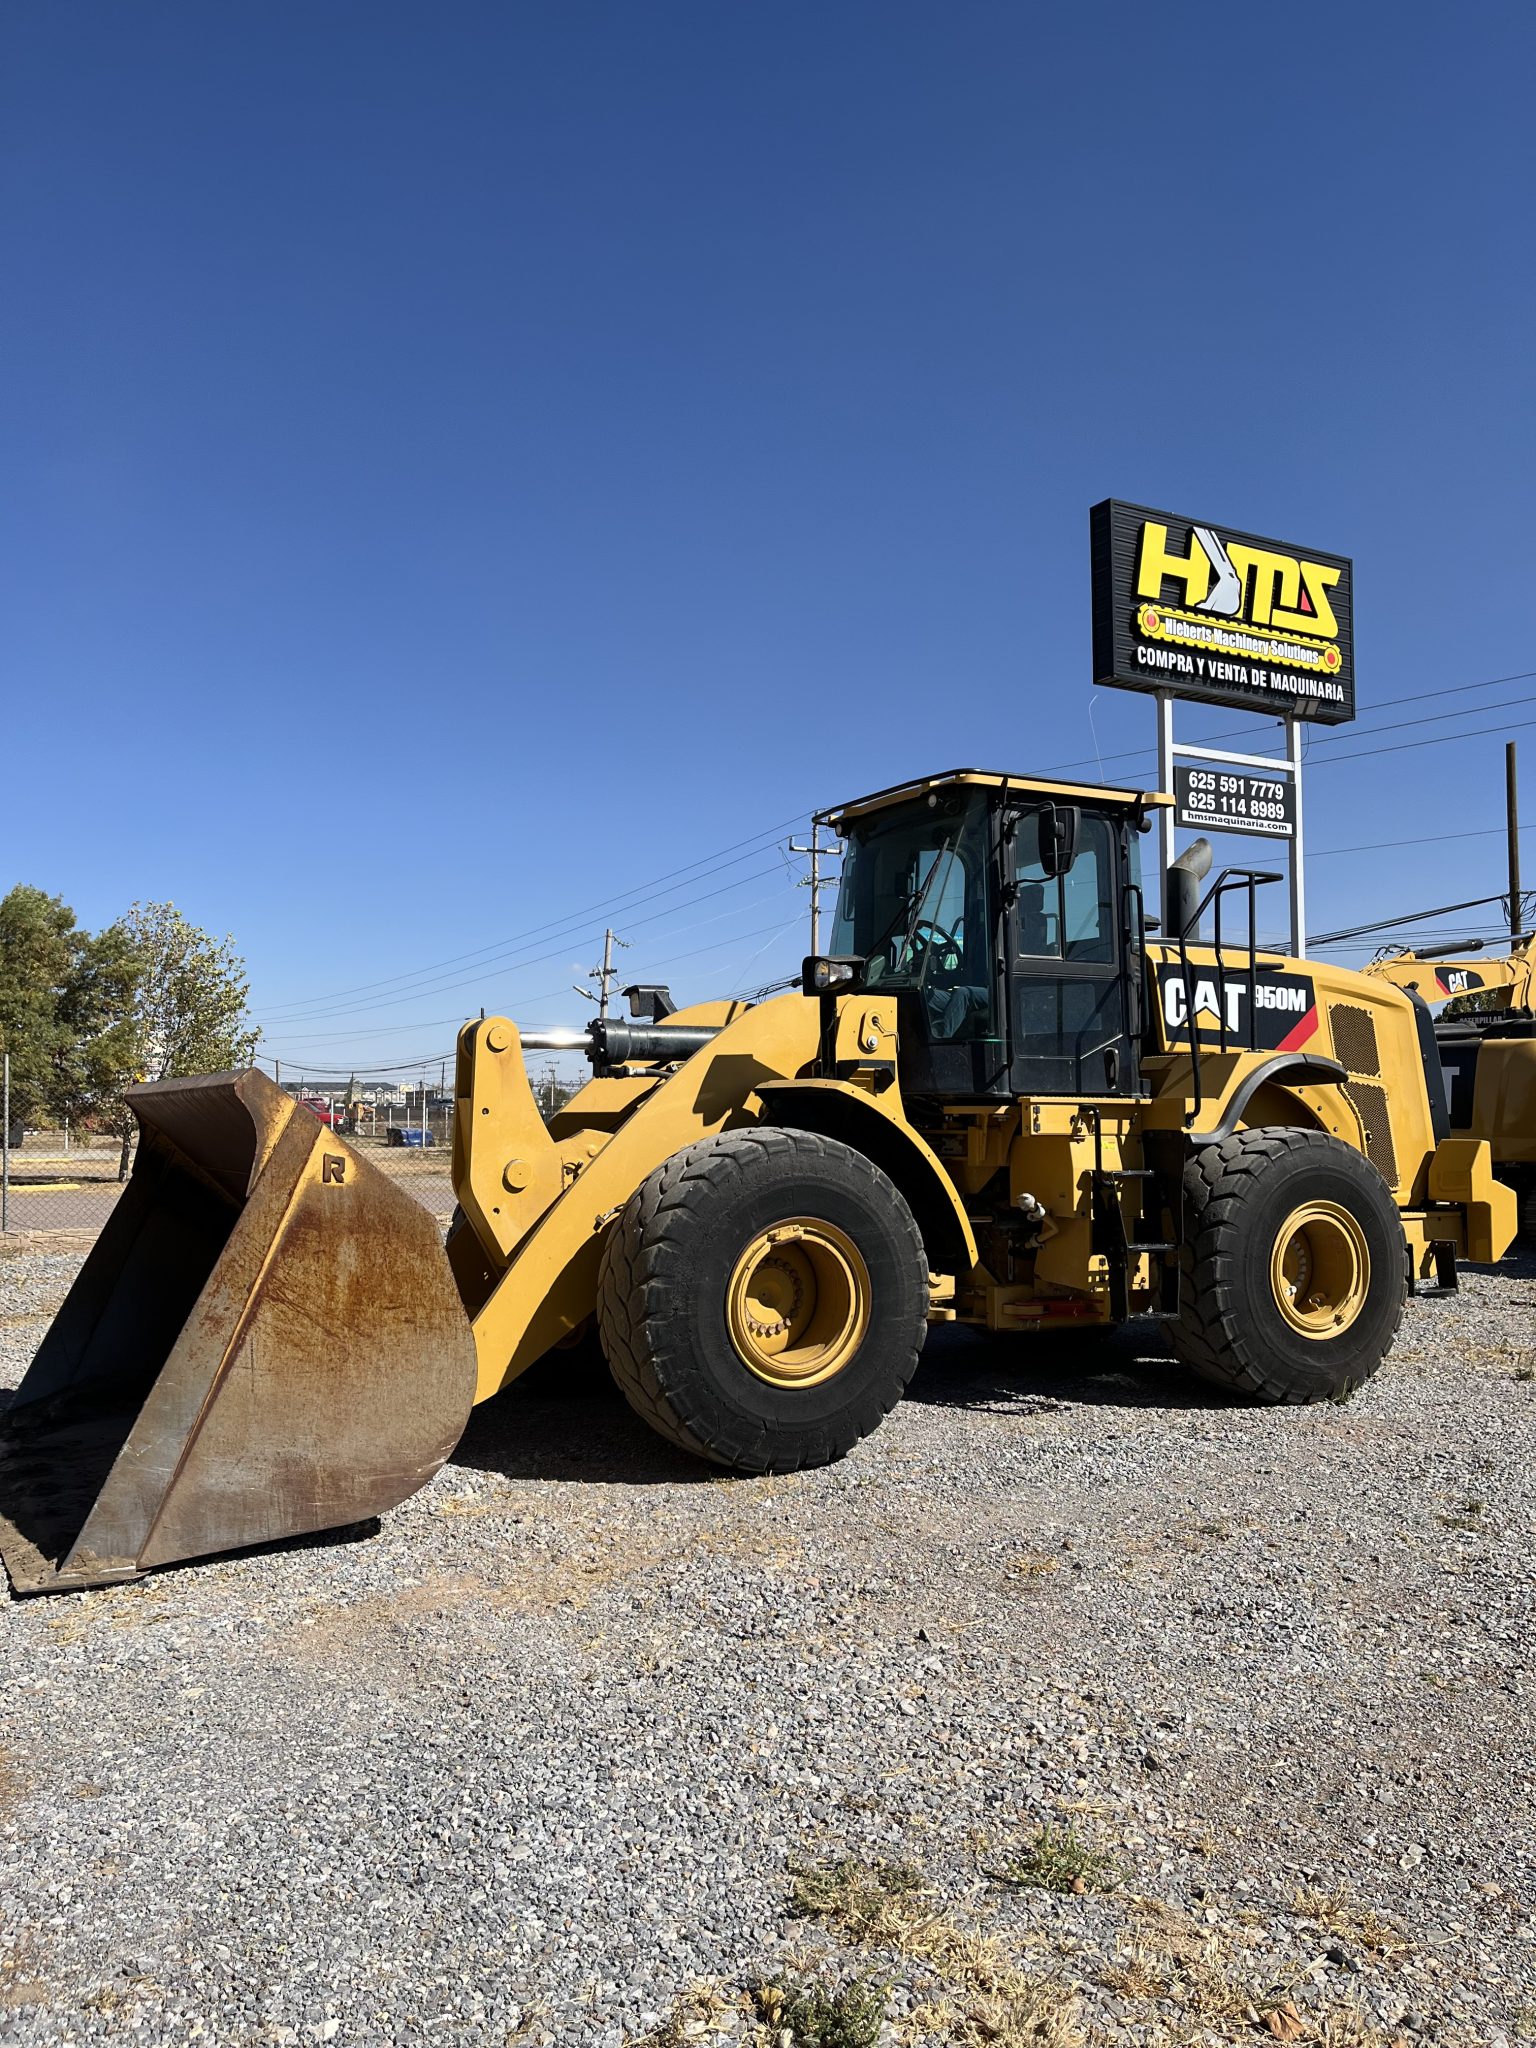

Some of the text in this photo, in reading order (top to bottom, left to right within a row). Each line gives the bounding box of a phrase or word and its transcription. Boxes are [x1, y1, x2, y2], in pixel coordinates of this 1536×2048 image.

[1165, 618, 1319, 665] Hieberts Machinery Solutions
[1137, 645, 1344, 702] COMPRA Y VENTA DE MAQUINARIA
[1188, 771, 1284, 800] 625 591 7779
[1188, 791, 1285, 820] 625 114 8989
[1187, 811, 1288, 831] hmsmaquinaria.com
[1448, 970, 1468, 993] CAT
[1164, 977, 1307, 1033] CAT 950M
[322, 1152, 346, 1184] R
